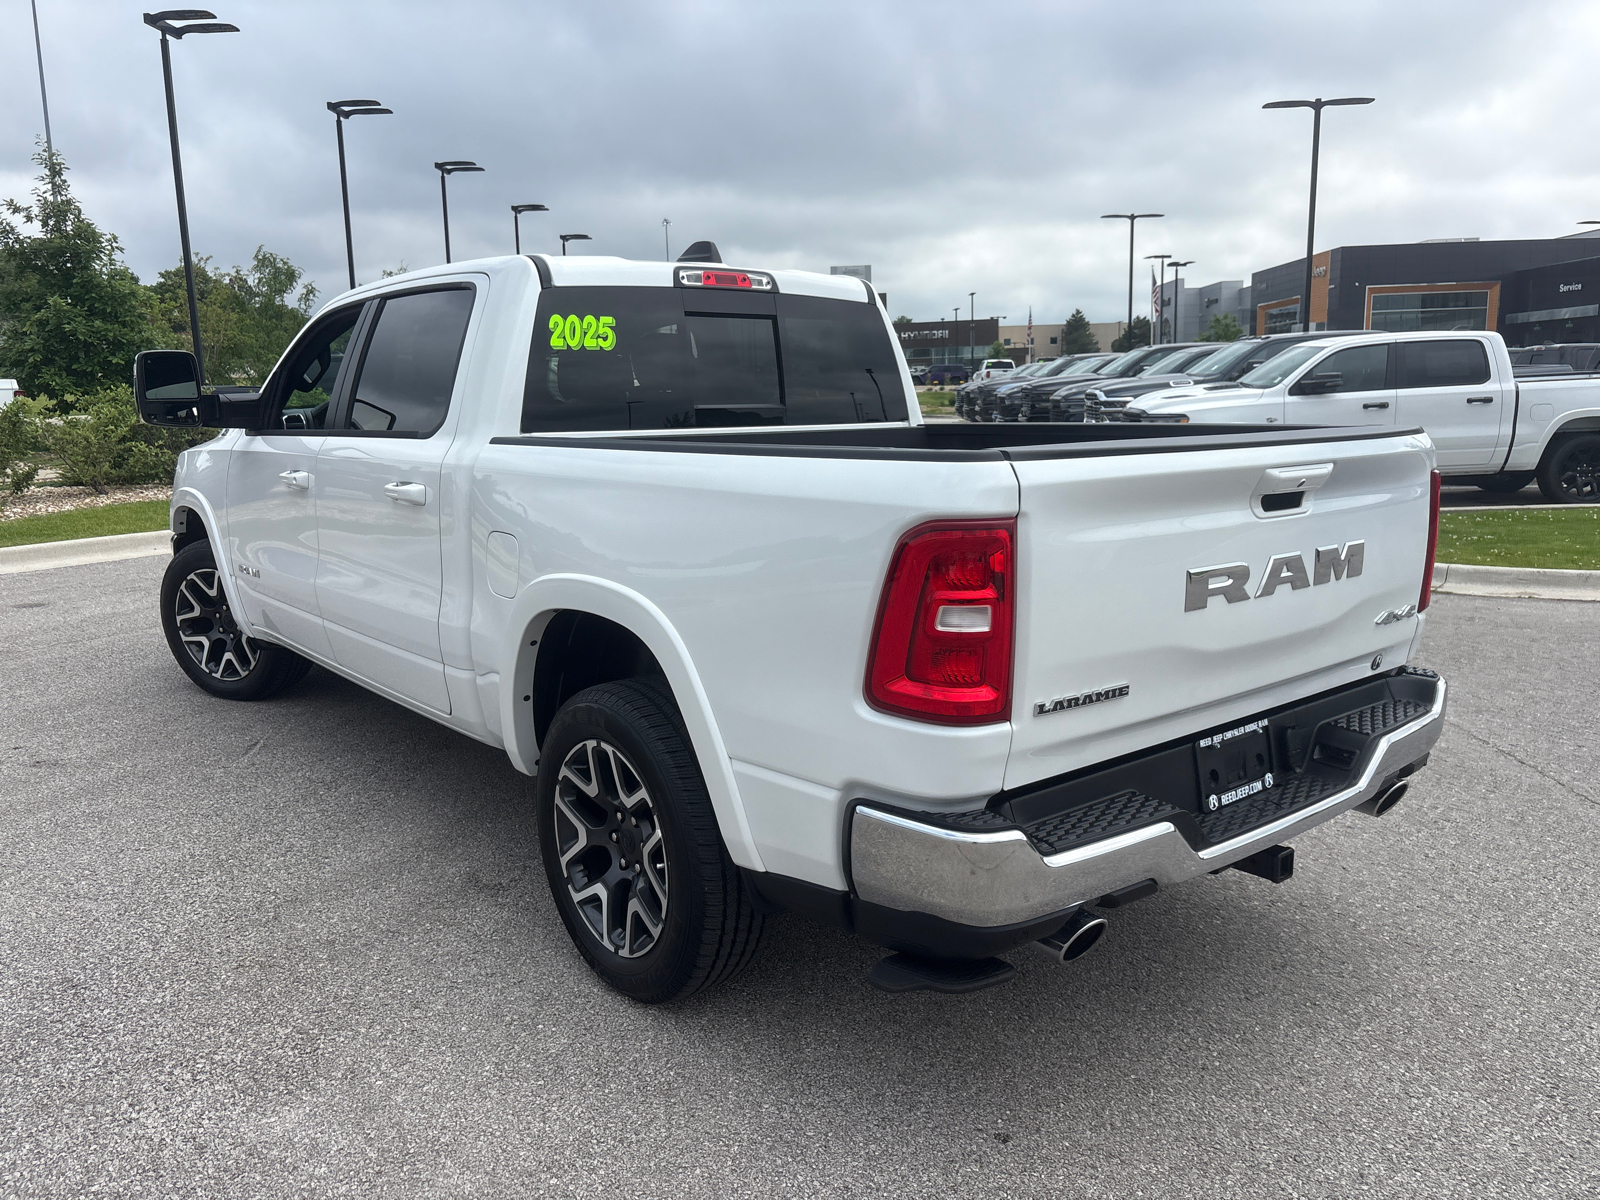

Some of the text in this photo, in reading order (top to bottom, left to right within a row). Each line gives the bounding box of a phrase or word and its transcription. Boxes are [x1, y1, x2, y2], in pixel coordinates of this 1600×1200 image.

[1559, 282, 1582, 292] Service
[549, 314, 616, 351] 2025
[1185, 539, 1365, 612] RAM
[1033, 682, 1130, 717] LARAMIE
[1200, 718, 1268, 747] REED JEEP CHRYSLER DODGE RAM
[1221, 781, 1263, 806] REEDJEEP.COM
